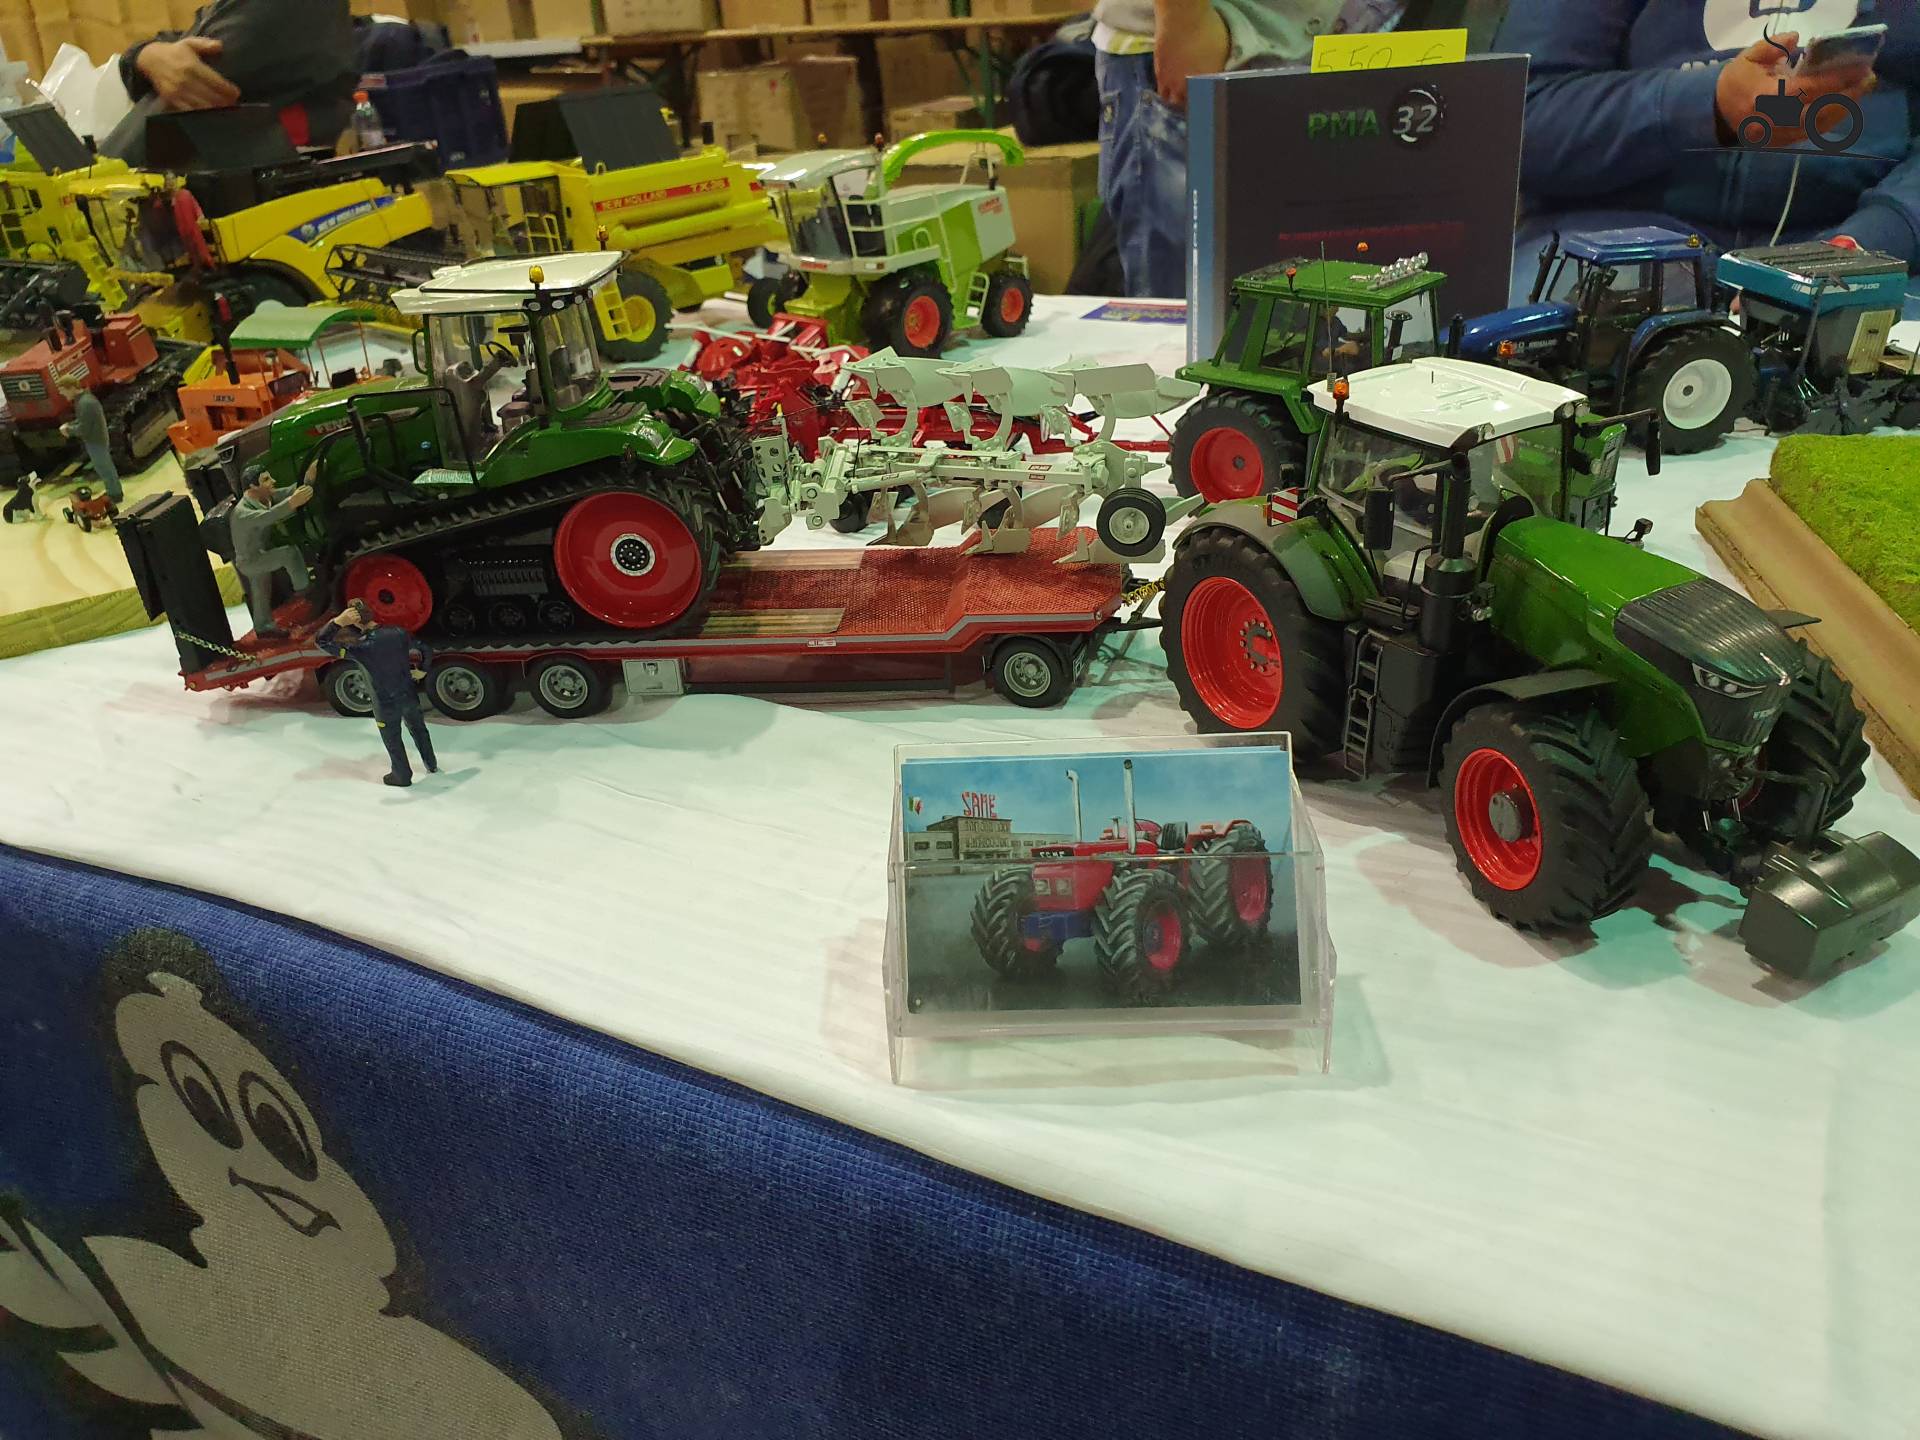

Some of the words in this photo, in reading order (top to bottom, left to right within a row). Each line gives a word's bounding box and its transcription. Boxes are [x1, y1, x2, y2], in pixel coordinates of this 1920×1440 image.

[1317, 45, 1393, 72] 550
[1308, 109, 1381, 140] PMA
[1392, 104, 1438, 135] 32
[961, 791, 998, 820] SAME
